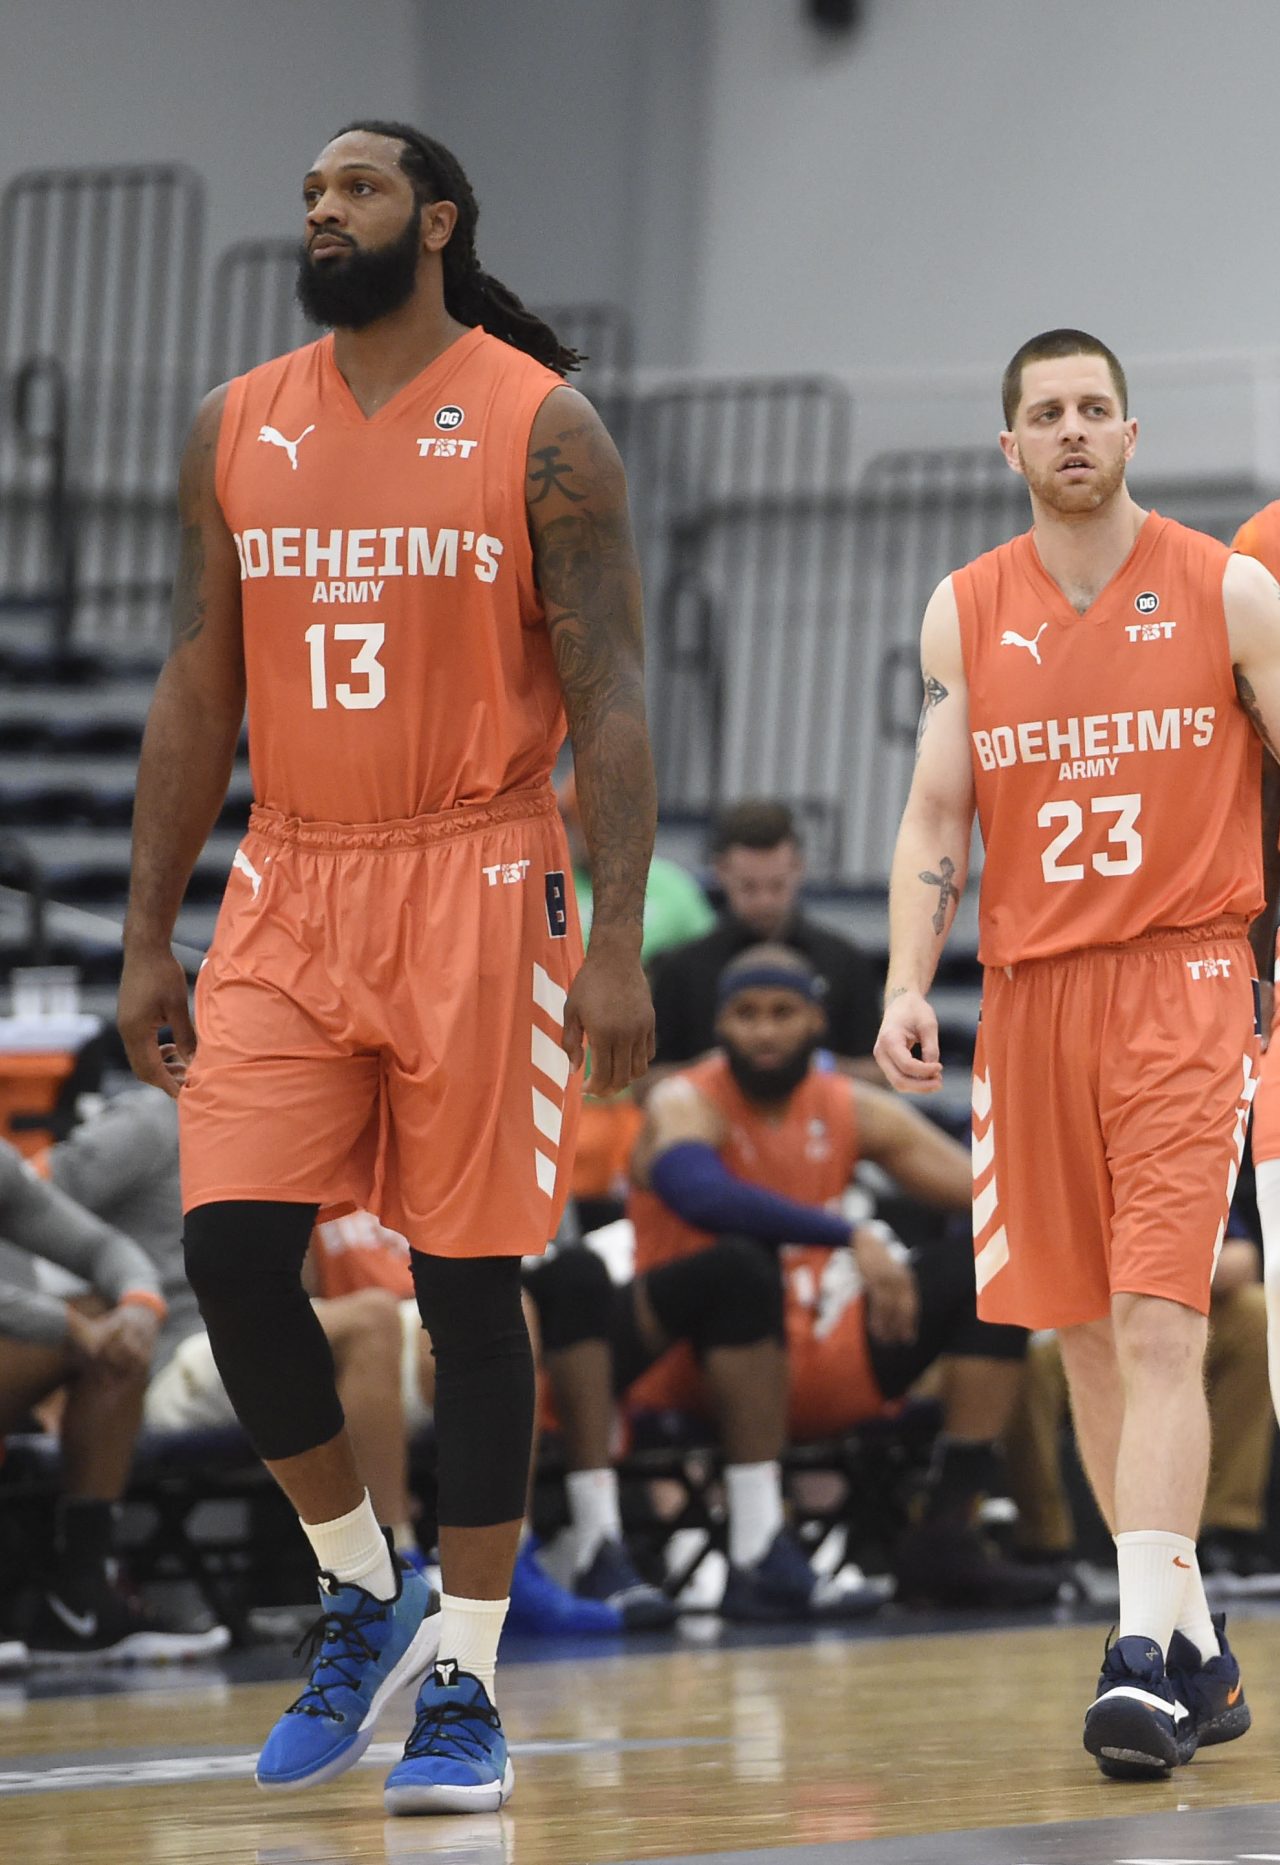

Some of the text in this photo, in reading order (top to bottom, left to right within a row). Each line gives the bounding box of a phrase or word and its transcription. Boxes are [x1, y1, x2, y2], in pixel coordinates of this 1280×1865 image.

[438, 411, 460, 425] DG
[416, 438, 478, 459] TBT
[312, 580, 385, 604] ARMY
[1138, 595, 1156, 610] DG
[1124, 621, 1177, 643] TBT
[304, 622, 387, 710] 13
[972, 706, 1216, 771] BOEHEIM'S
[1058, 757, 1119, 781] ARMY
[1036, 793, 1143, 883] 23
